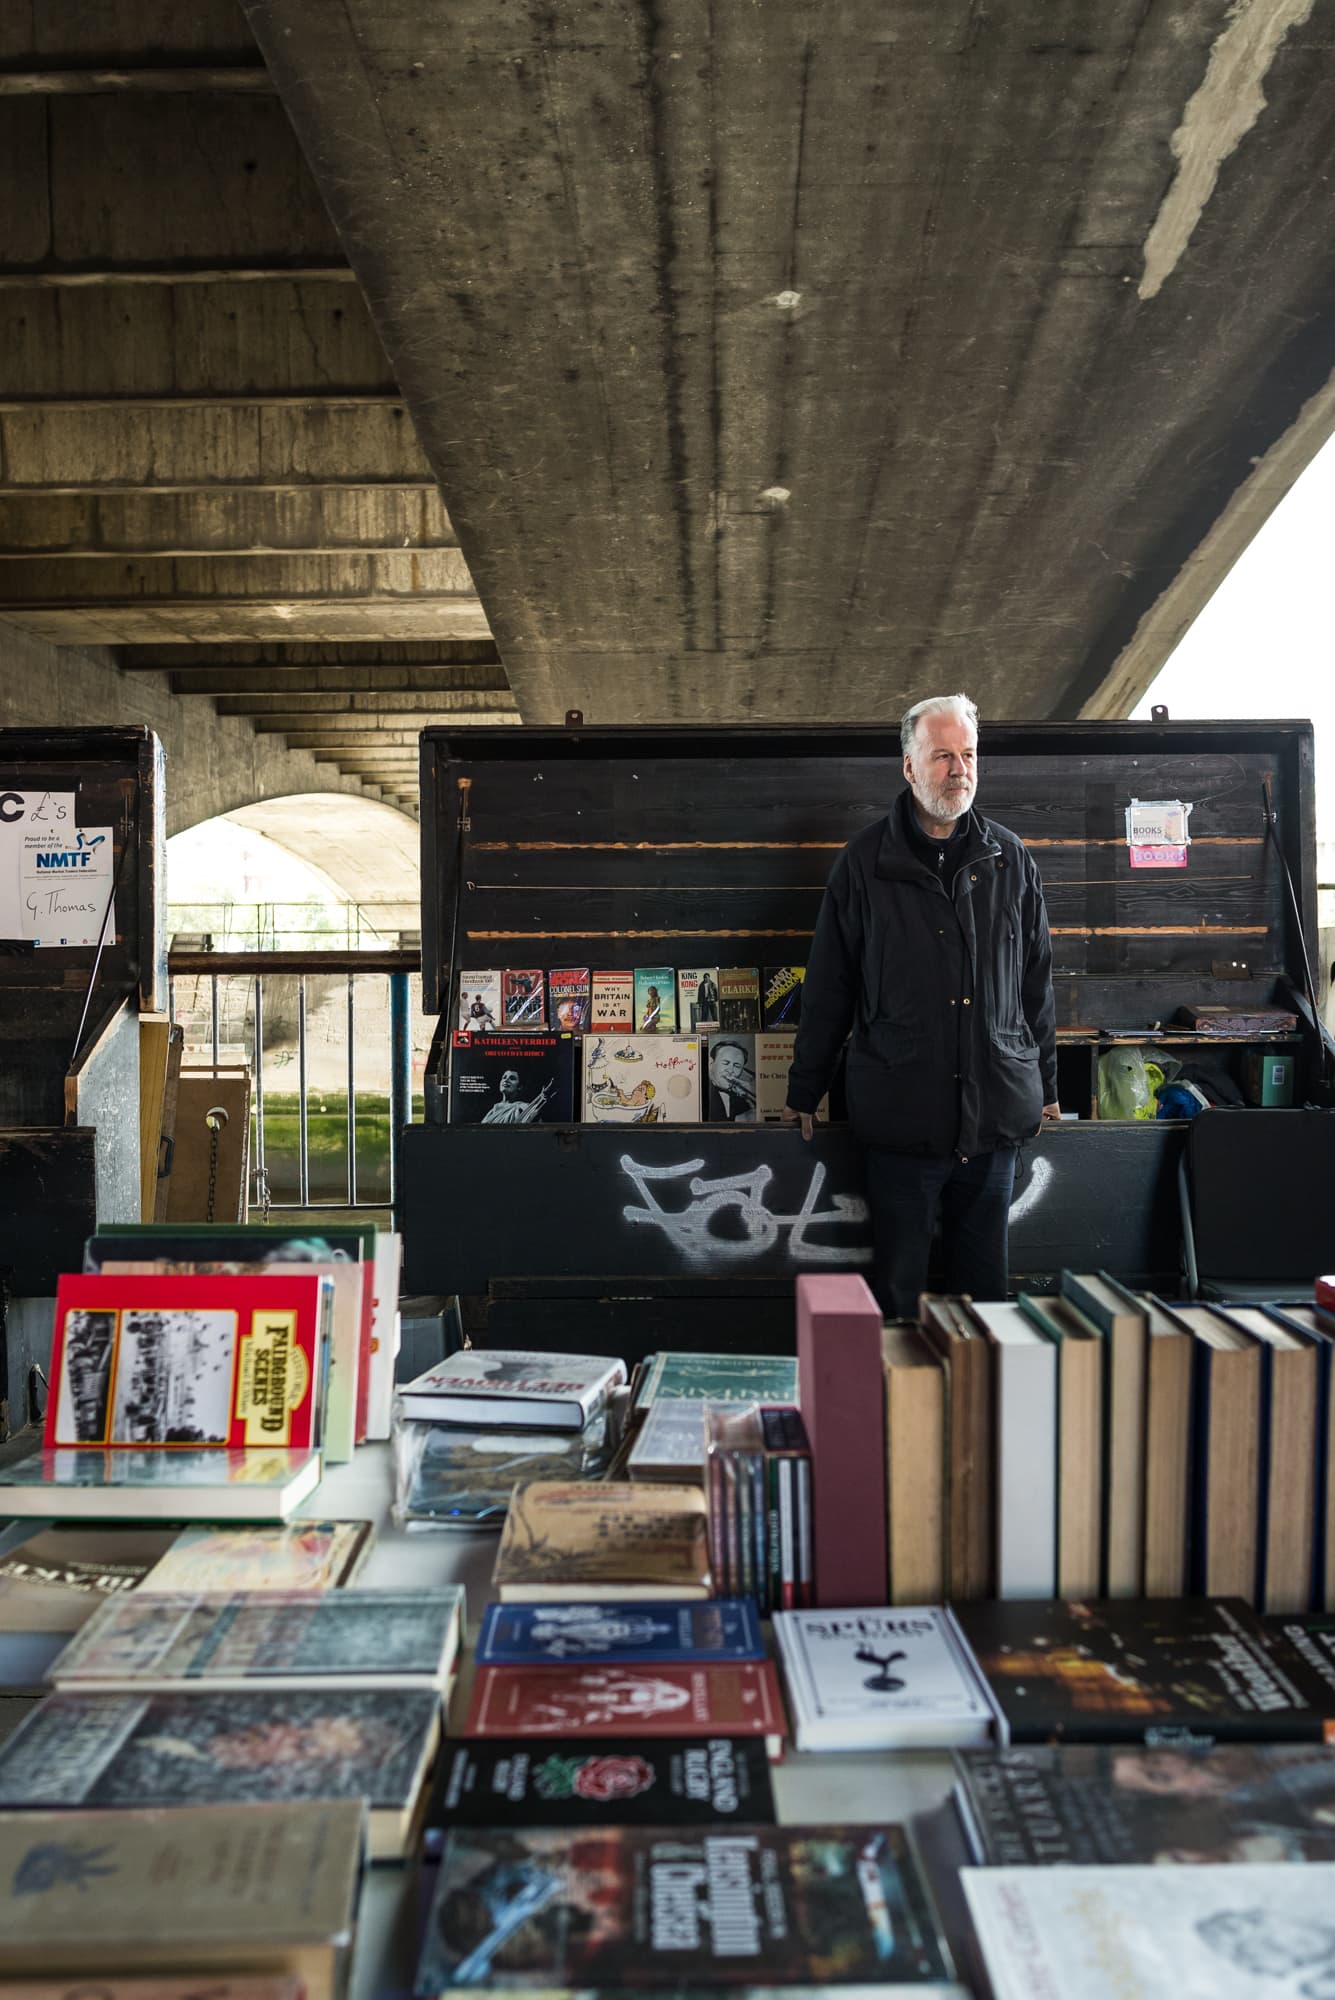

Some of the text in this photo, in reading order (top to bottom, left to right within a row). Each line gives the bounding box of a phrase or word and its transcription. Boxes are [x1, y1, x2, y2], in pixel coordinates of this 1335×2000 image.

[1133, 826, 1162, 834] BOOKS
[36, 852, 91, 868] NMTF
[45, 888, 97, 916] Thomas
[681, 972, 698, 980] KING
[681, 980, 698, 988] KONG
[770, 968, 789, 986] LAST
[549, 984, 589, 994] COLONEL SUN
[721, 985, 757, 994] CLARKE
[765, 975, 800, 1008] BROOKLYN
[597, 1009, 627, 1017] WAR
[474, 1038, 557, 1046] KATHLEEN FERRIER
[252, 1348, 270, 1407] SCENES
[260, 1325, 289, 1433] FAIRGROUND
[684, 1748, 710, 1801] RUGBY
[708, 1739, 739, 1813] ENGLAND
[704, 1835, 762, 1957] Kensington
[650, 1862, 708, 1951] Chelsea
